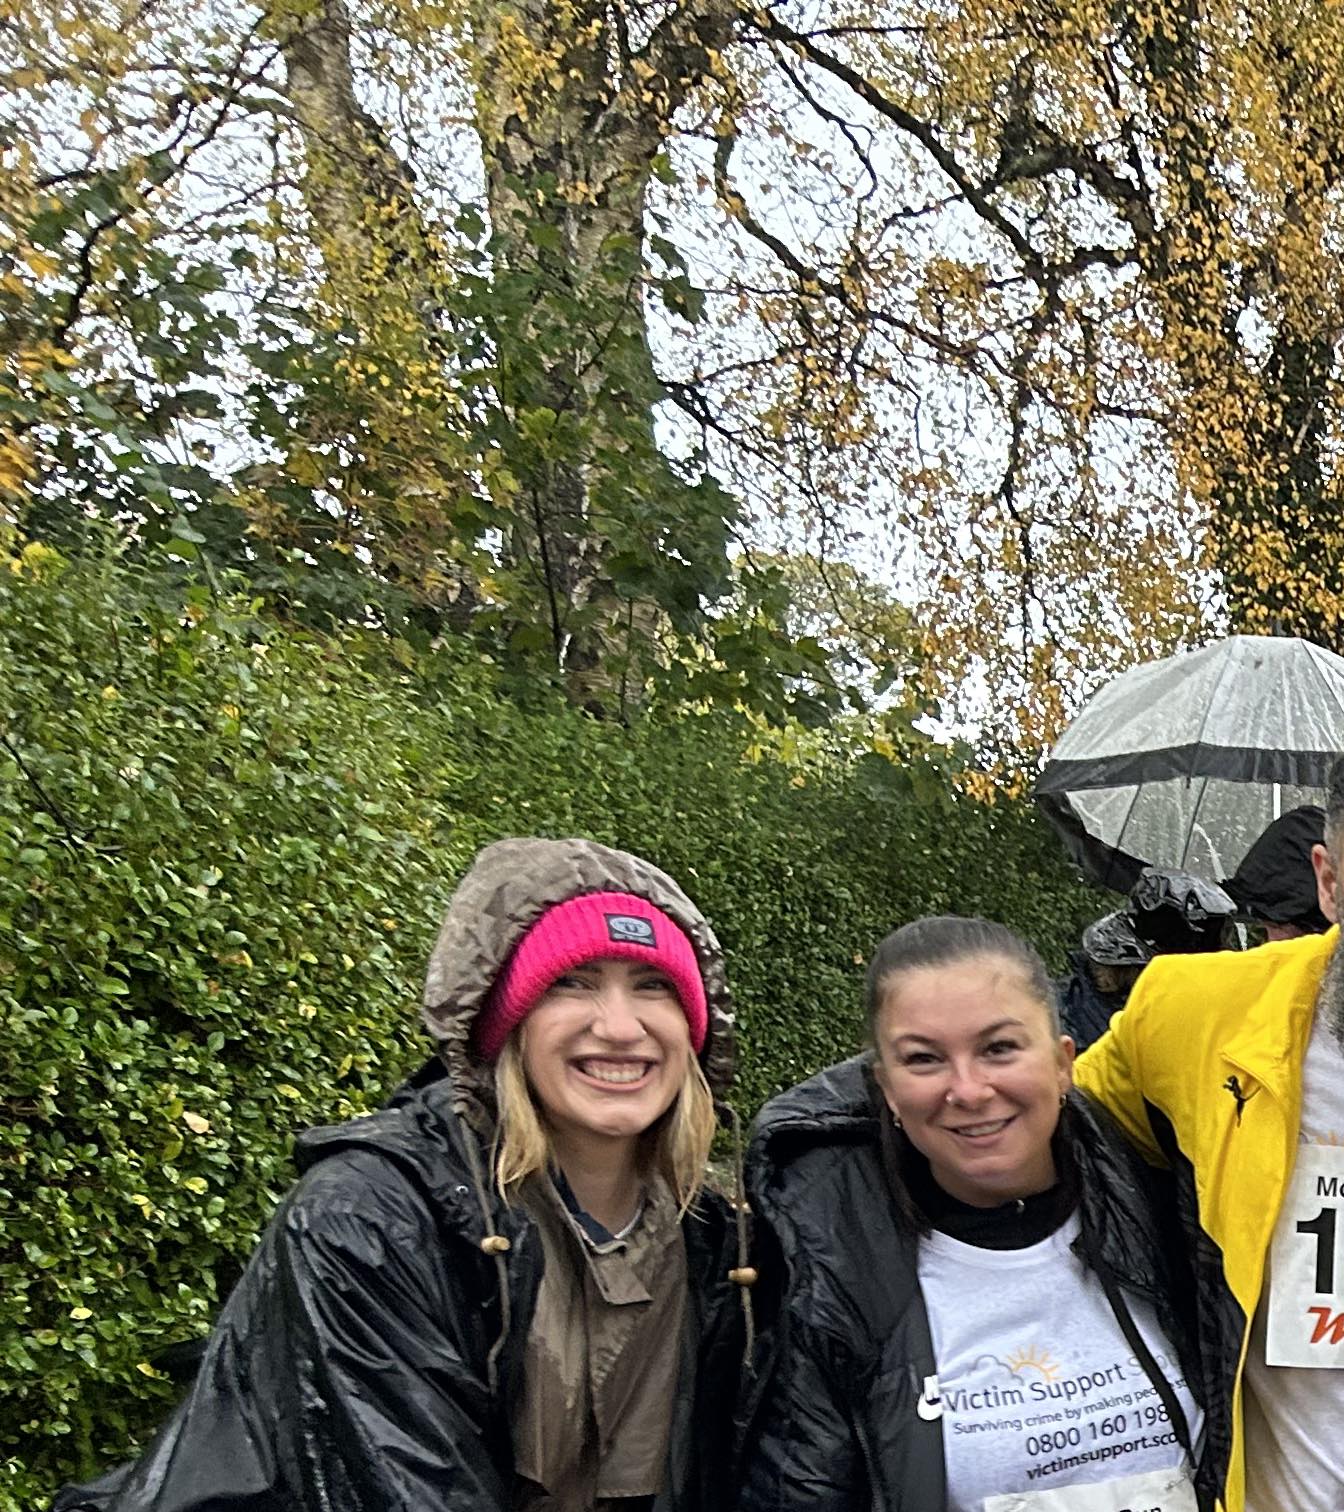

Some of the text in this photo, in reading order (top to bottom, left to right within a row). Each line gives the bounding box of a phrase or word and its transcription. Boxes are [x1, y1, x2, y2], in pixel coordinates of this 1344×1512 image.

[942, 1387, 1025, 1415] Victim
[1030, 1363, 1127, 1404] Support
[1024, 1411, 1063, 1428] crime
[1065, 1406, 1083, 1424] by
[1084, 1393, 1133, 1421] making
[1134, 1387, 1158, 1403] peo
[1025, 1404, 1169, 1457] 0800 160 198
[1025, 1432, 1177, 1480] victimsupport.sco
